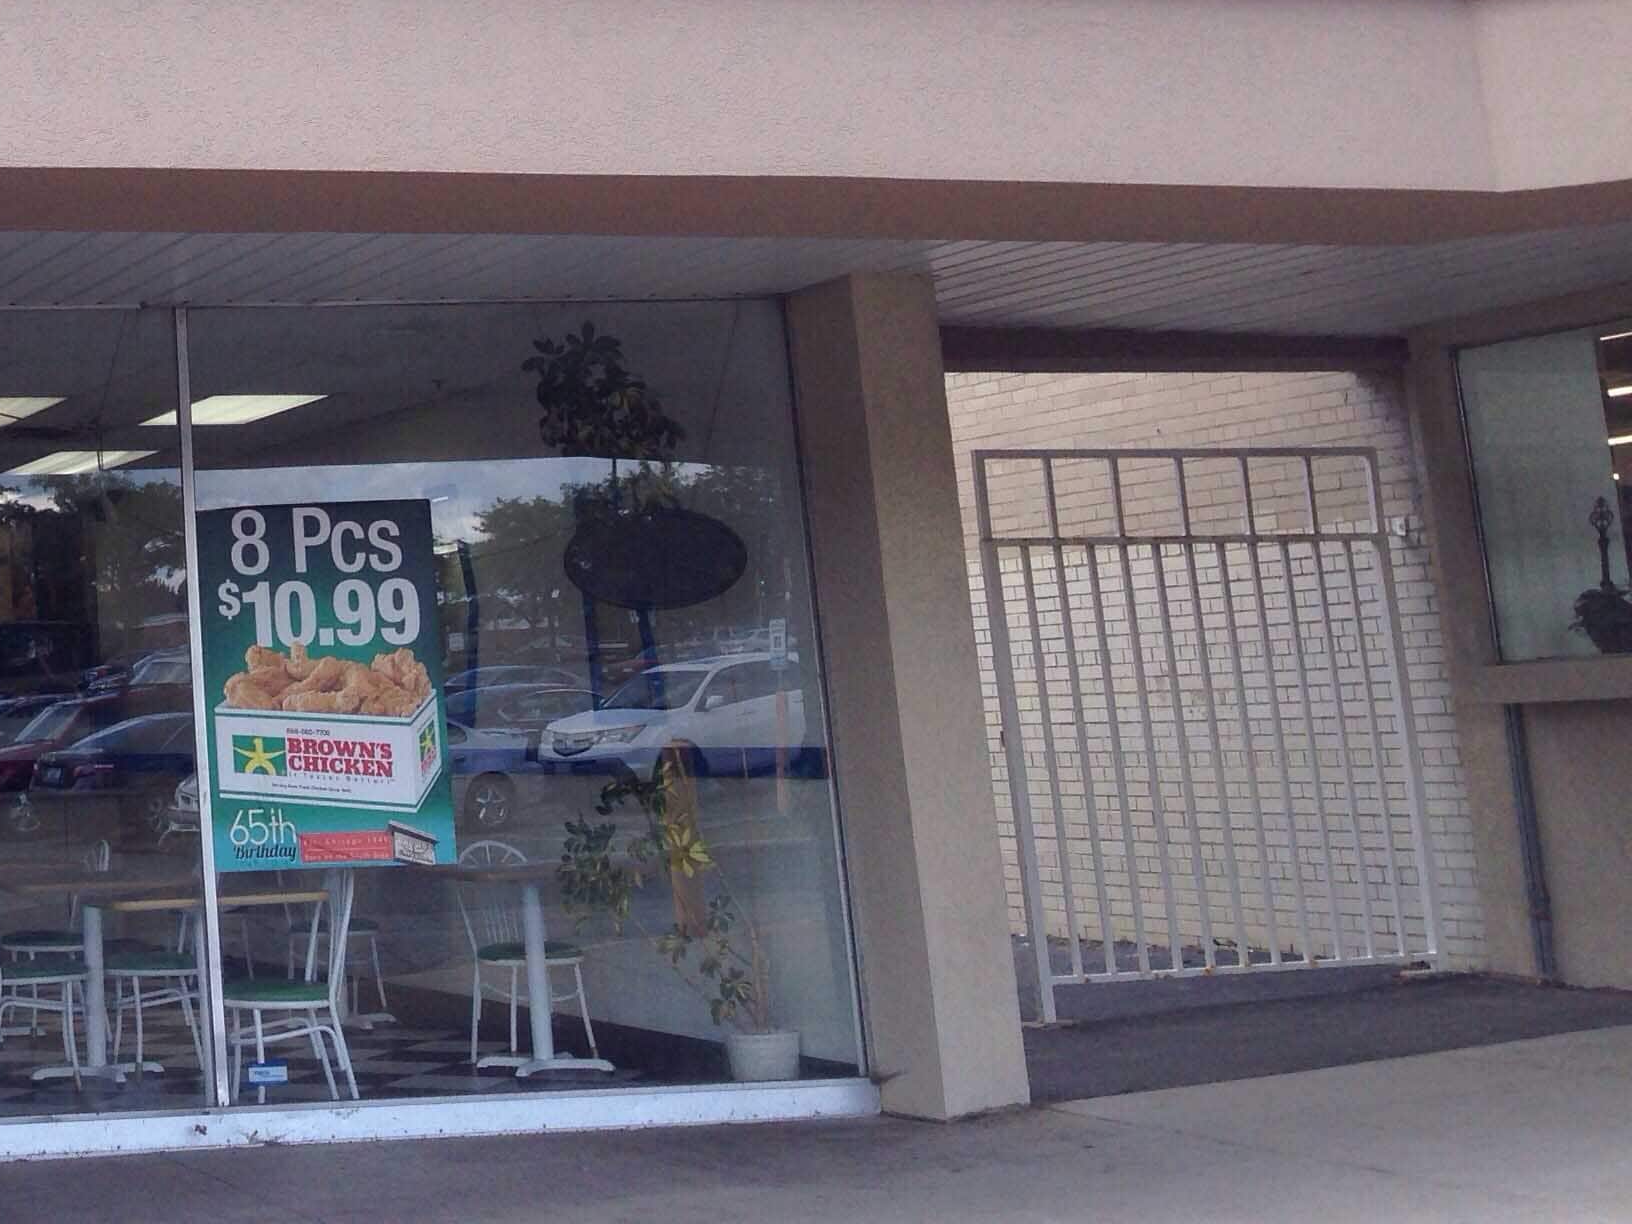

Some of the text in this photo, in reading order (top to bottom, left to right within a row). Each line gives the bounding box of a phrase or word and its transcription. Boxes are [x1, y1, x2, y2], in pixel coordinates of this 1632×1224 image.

[230, 509, 270, 576] 8
[217, 577, 421, 647] $10.99
[286, 737, 393, 760] BROWN'S
[288, 755, 393, 778] CHICKEN
[229, 807, 298, 846] 65th
[234, 843, 297, 862] Birthday
